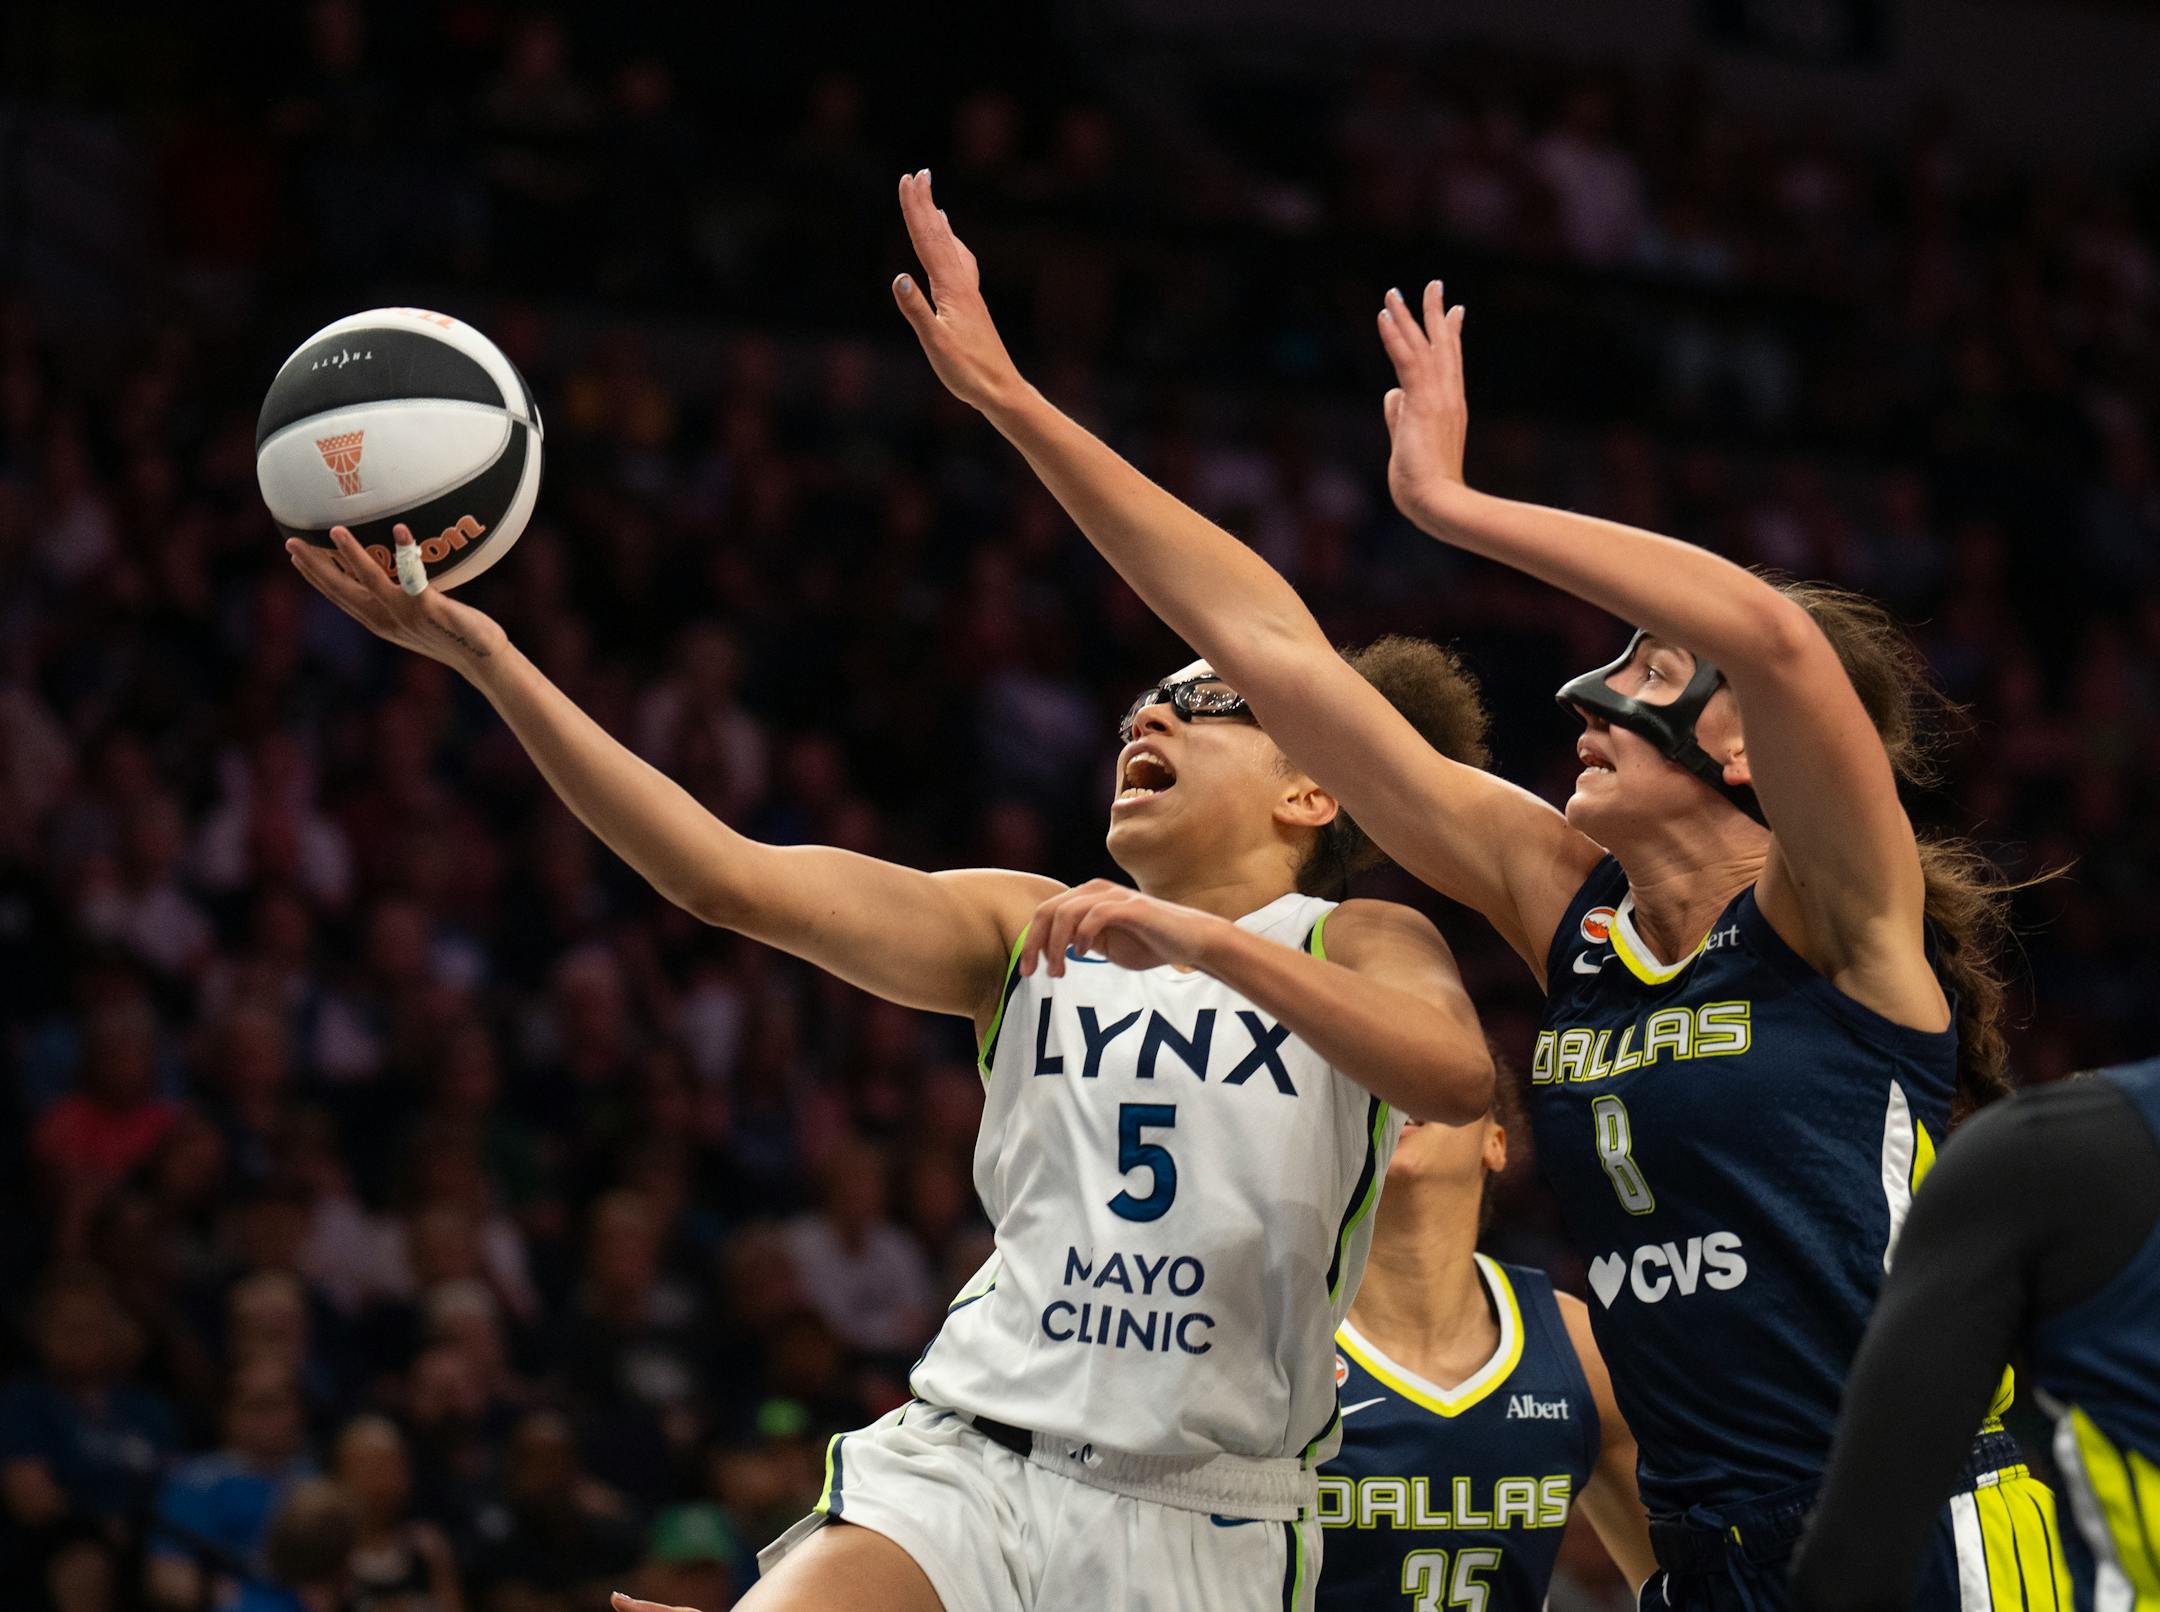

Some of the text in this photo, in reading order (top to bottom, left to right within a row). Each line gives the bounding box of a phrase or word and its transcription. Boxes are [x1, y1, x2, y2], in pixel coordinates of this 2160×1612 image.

[1706, 924, 1740, 951] ert
[1034, 996, 1298, 1097] LYNX
[1531, 1000, 1751, 1085] DALLAS
[1107, 1102, 1177, 1223] 5
[1591, 1094, 1656, 1216] 8
[1063, 1246, 1205, 1297] MAYO
[1630, 1231, 1748, 1304] CVS
[1041, 1300, 1216, 1355] CLINIC
[1506, 1394, 1569, 1420] Albert
[1318, 1474, 1572, 1531] DALLAS
